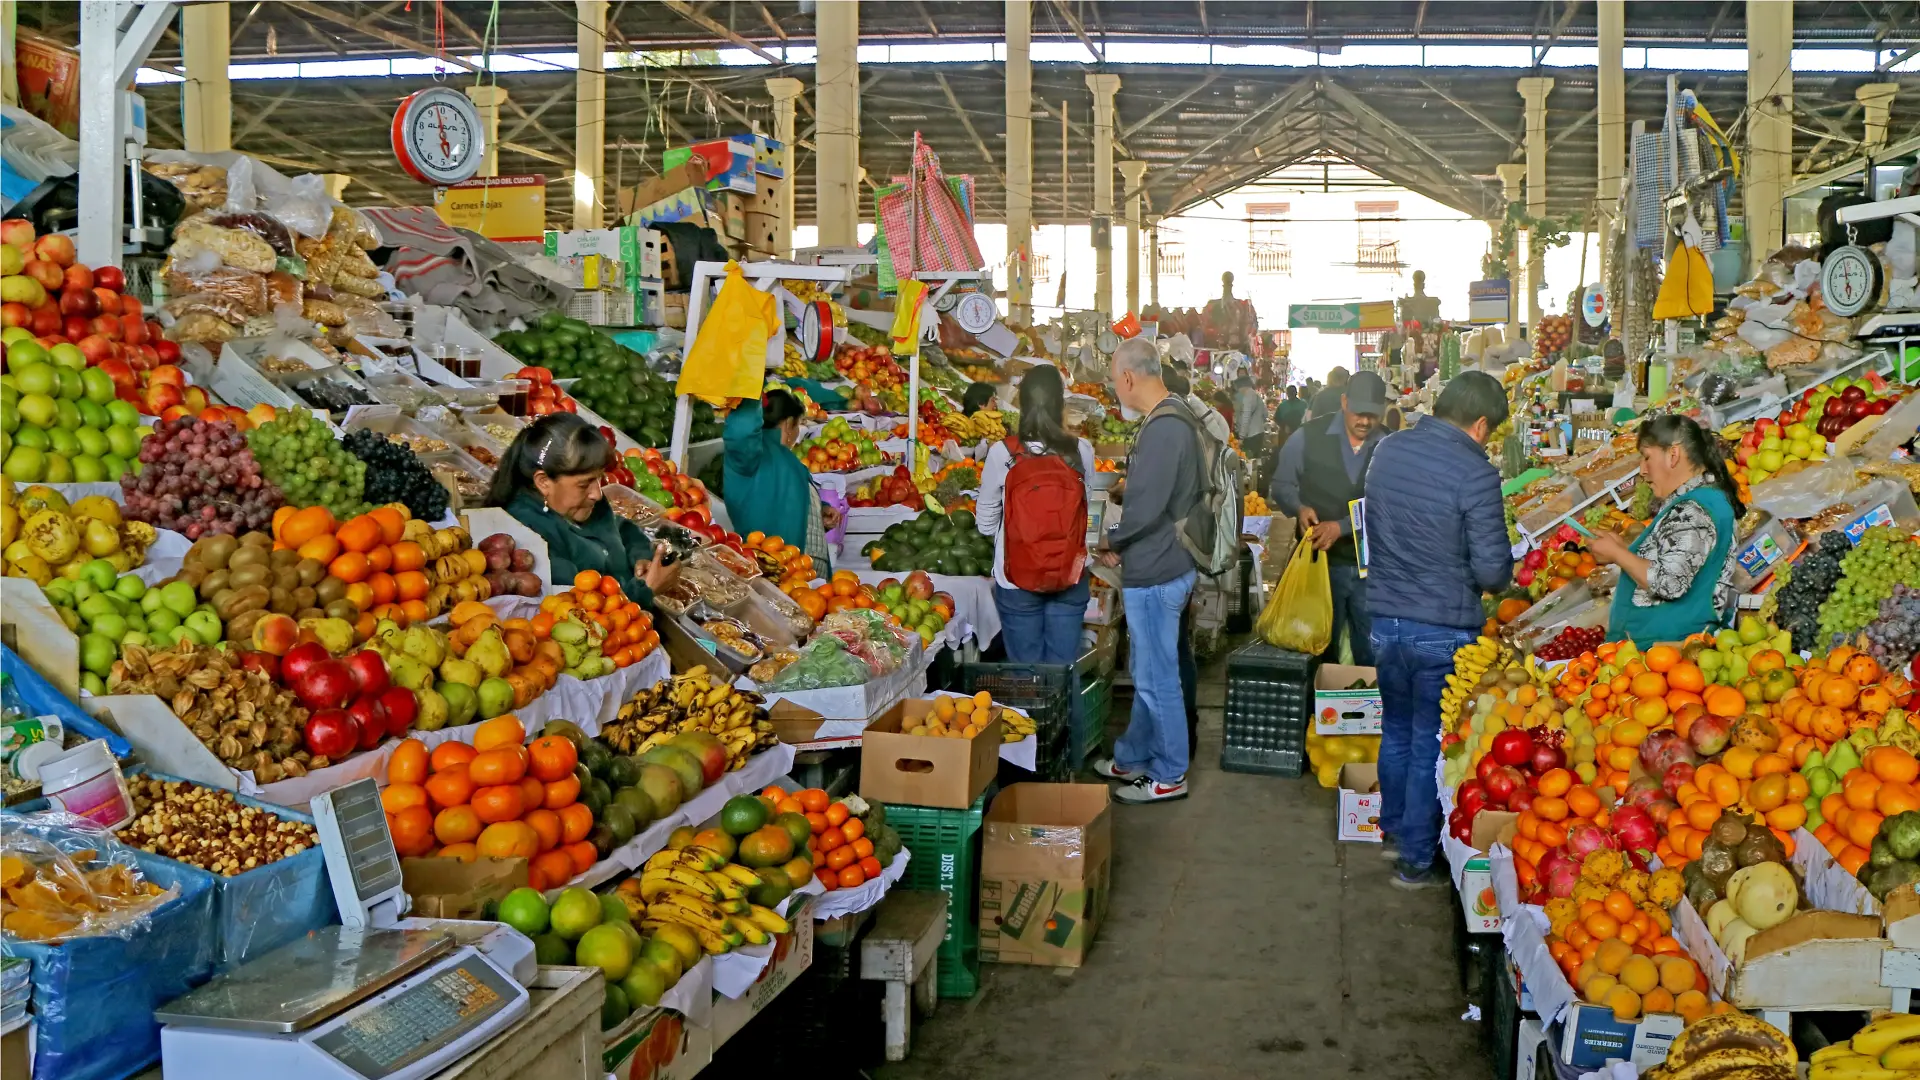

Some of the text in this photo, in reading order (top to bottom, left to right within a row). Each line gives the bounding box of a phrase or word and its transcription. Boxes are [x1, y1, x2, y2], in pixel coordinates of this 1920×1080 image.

[500, 177, 513, 185] DEL
[513, 176, 535, 185] CUSCO
[450, 200, 503, 211] Carnes Rojas
[1303, 310, 1343, 321] SALIDA
[940, 853, 955, 880] DIST.
[1584, 1038, 1623, 1048] CHERRIES
